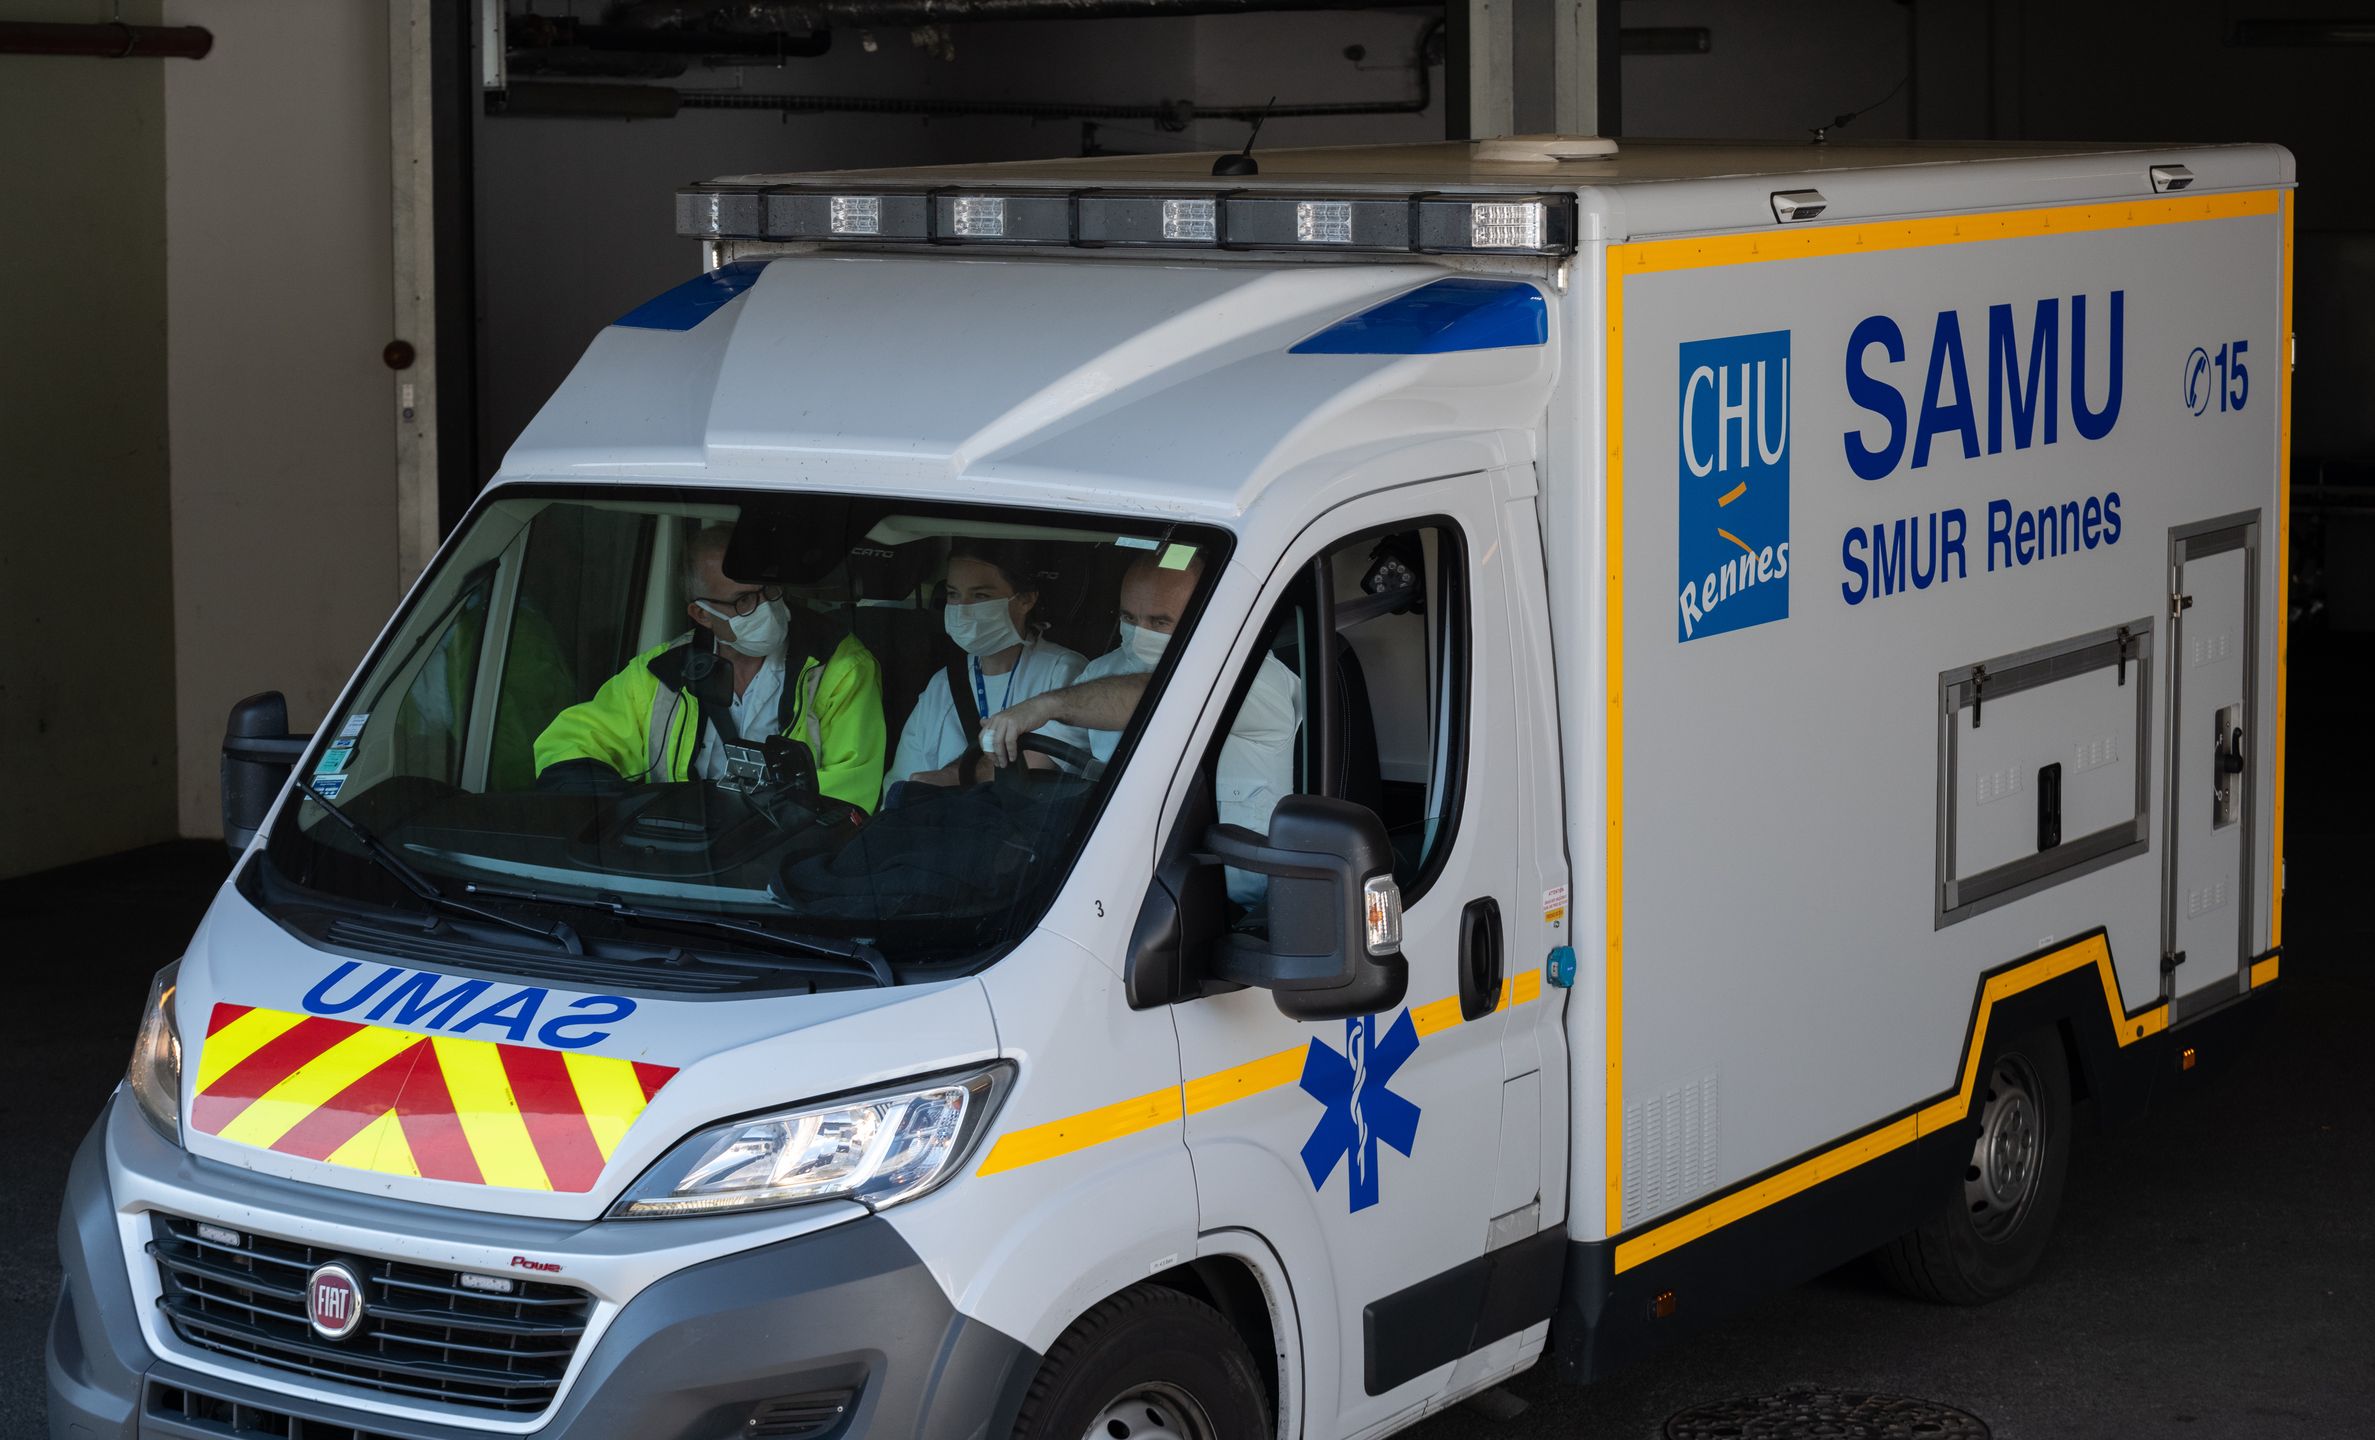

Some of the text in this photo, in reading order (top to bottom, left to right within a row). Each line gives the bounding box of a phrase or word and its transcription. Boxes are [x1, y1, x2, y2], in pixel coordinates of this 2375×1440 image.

[1682, 357, 1787, 478] CHU
[1844, 289, 2124, 481] SAMU
[2215, 341, 2248, 411] 15
[1680, 542, 1789, 638] Rennes
[1842, 492, 2121, 605] SMUR Rennes
[1095, 900, 1104, 917] 3
[318, 1285, 349, 1319] FIAT
